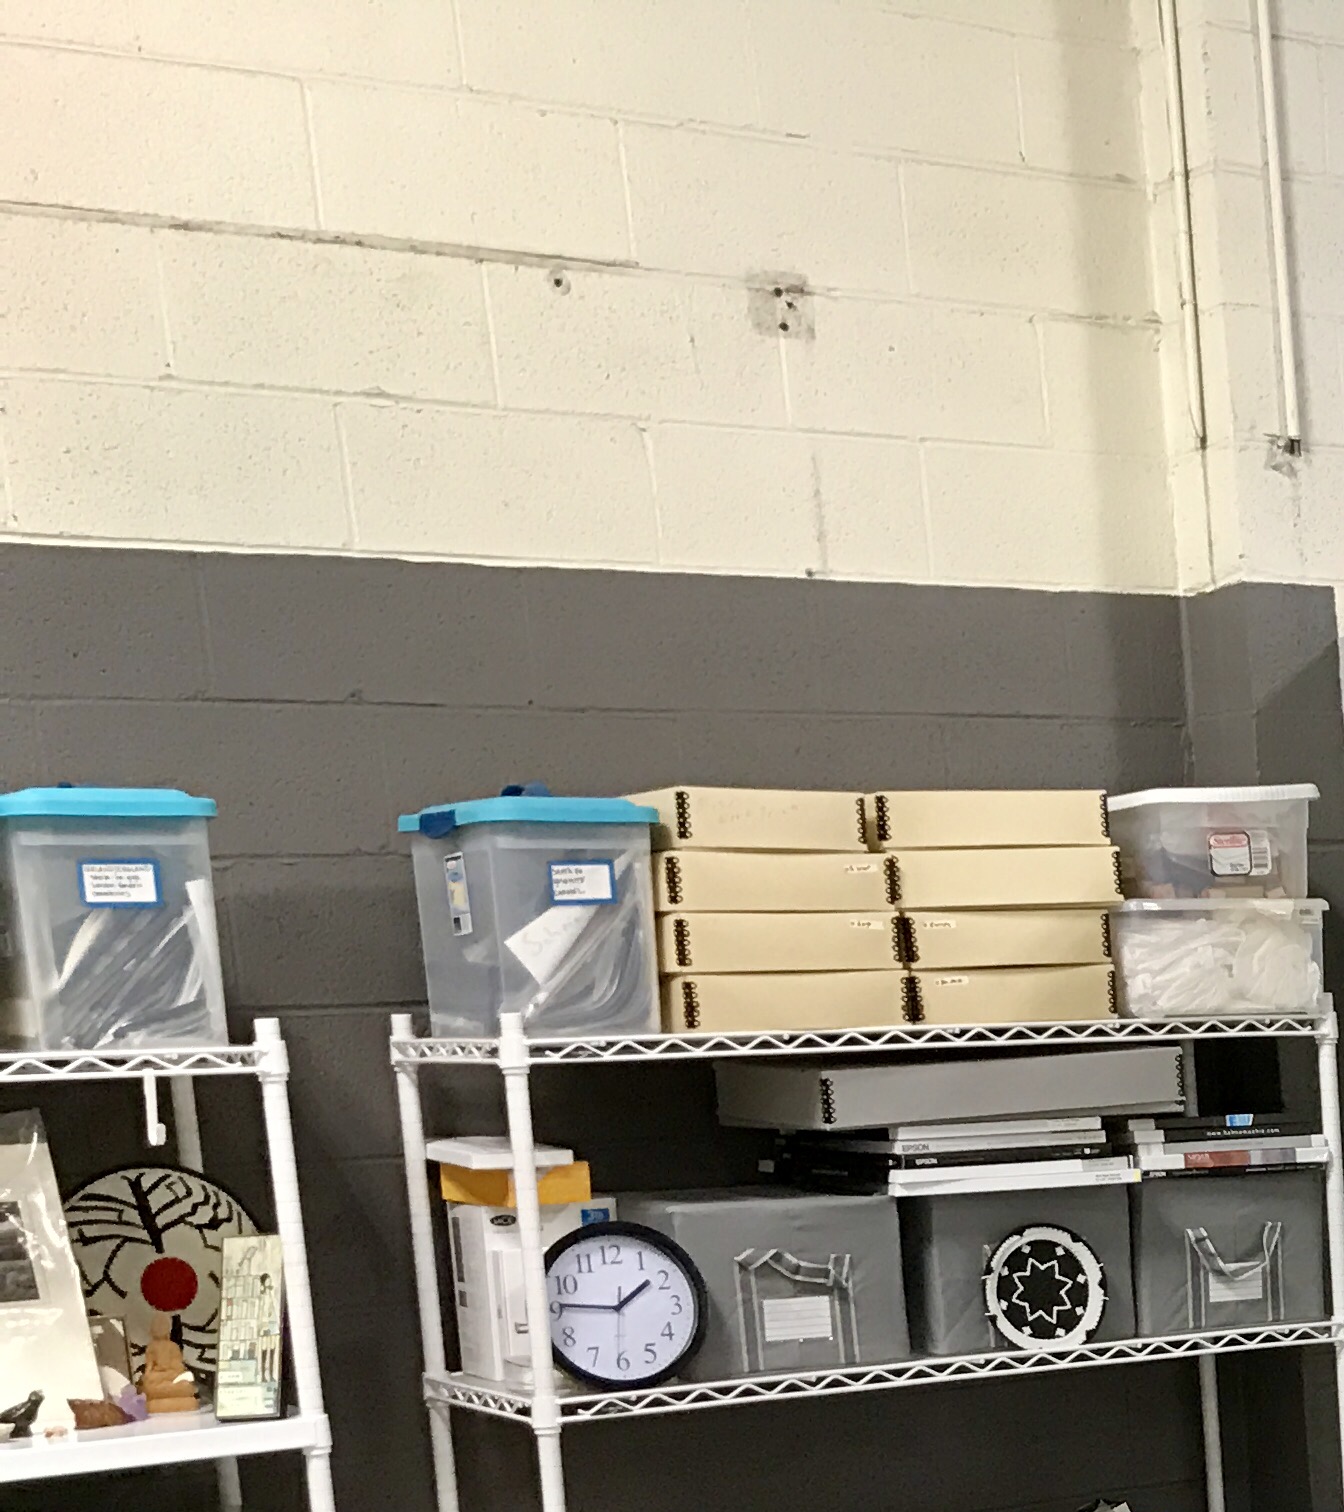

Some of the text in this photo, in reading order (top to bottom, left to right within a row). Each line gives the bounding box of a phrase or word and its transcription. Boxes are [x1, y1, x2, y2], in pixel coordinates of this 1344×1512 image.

[901, 1143, 930, 1152] EPSON
[576, 1253, 594, 1274] 11
[600, 1244, 623, 1265] 12
[637, 1251, 645, 1271] 1
[554, 1274, 578, 1295] 10
[657, 1269, 671, 1290] 2
[550, 1301, 563, 1321] 9
[670, 1294, 682, 1315] 3
[562, 1326, 576, 1347] 8
[660, 1321, 675, 1341] 4
[587, 1346, 600, 1367] 7
[616, 1351, 630, 1371] 6
[643, 1342, 657, 1364] 5
